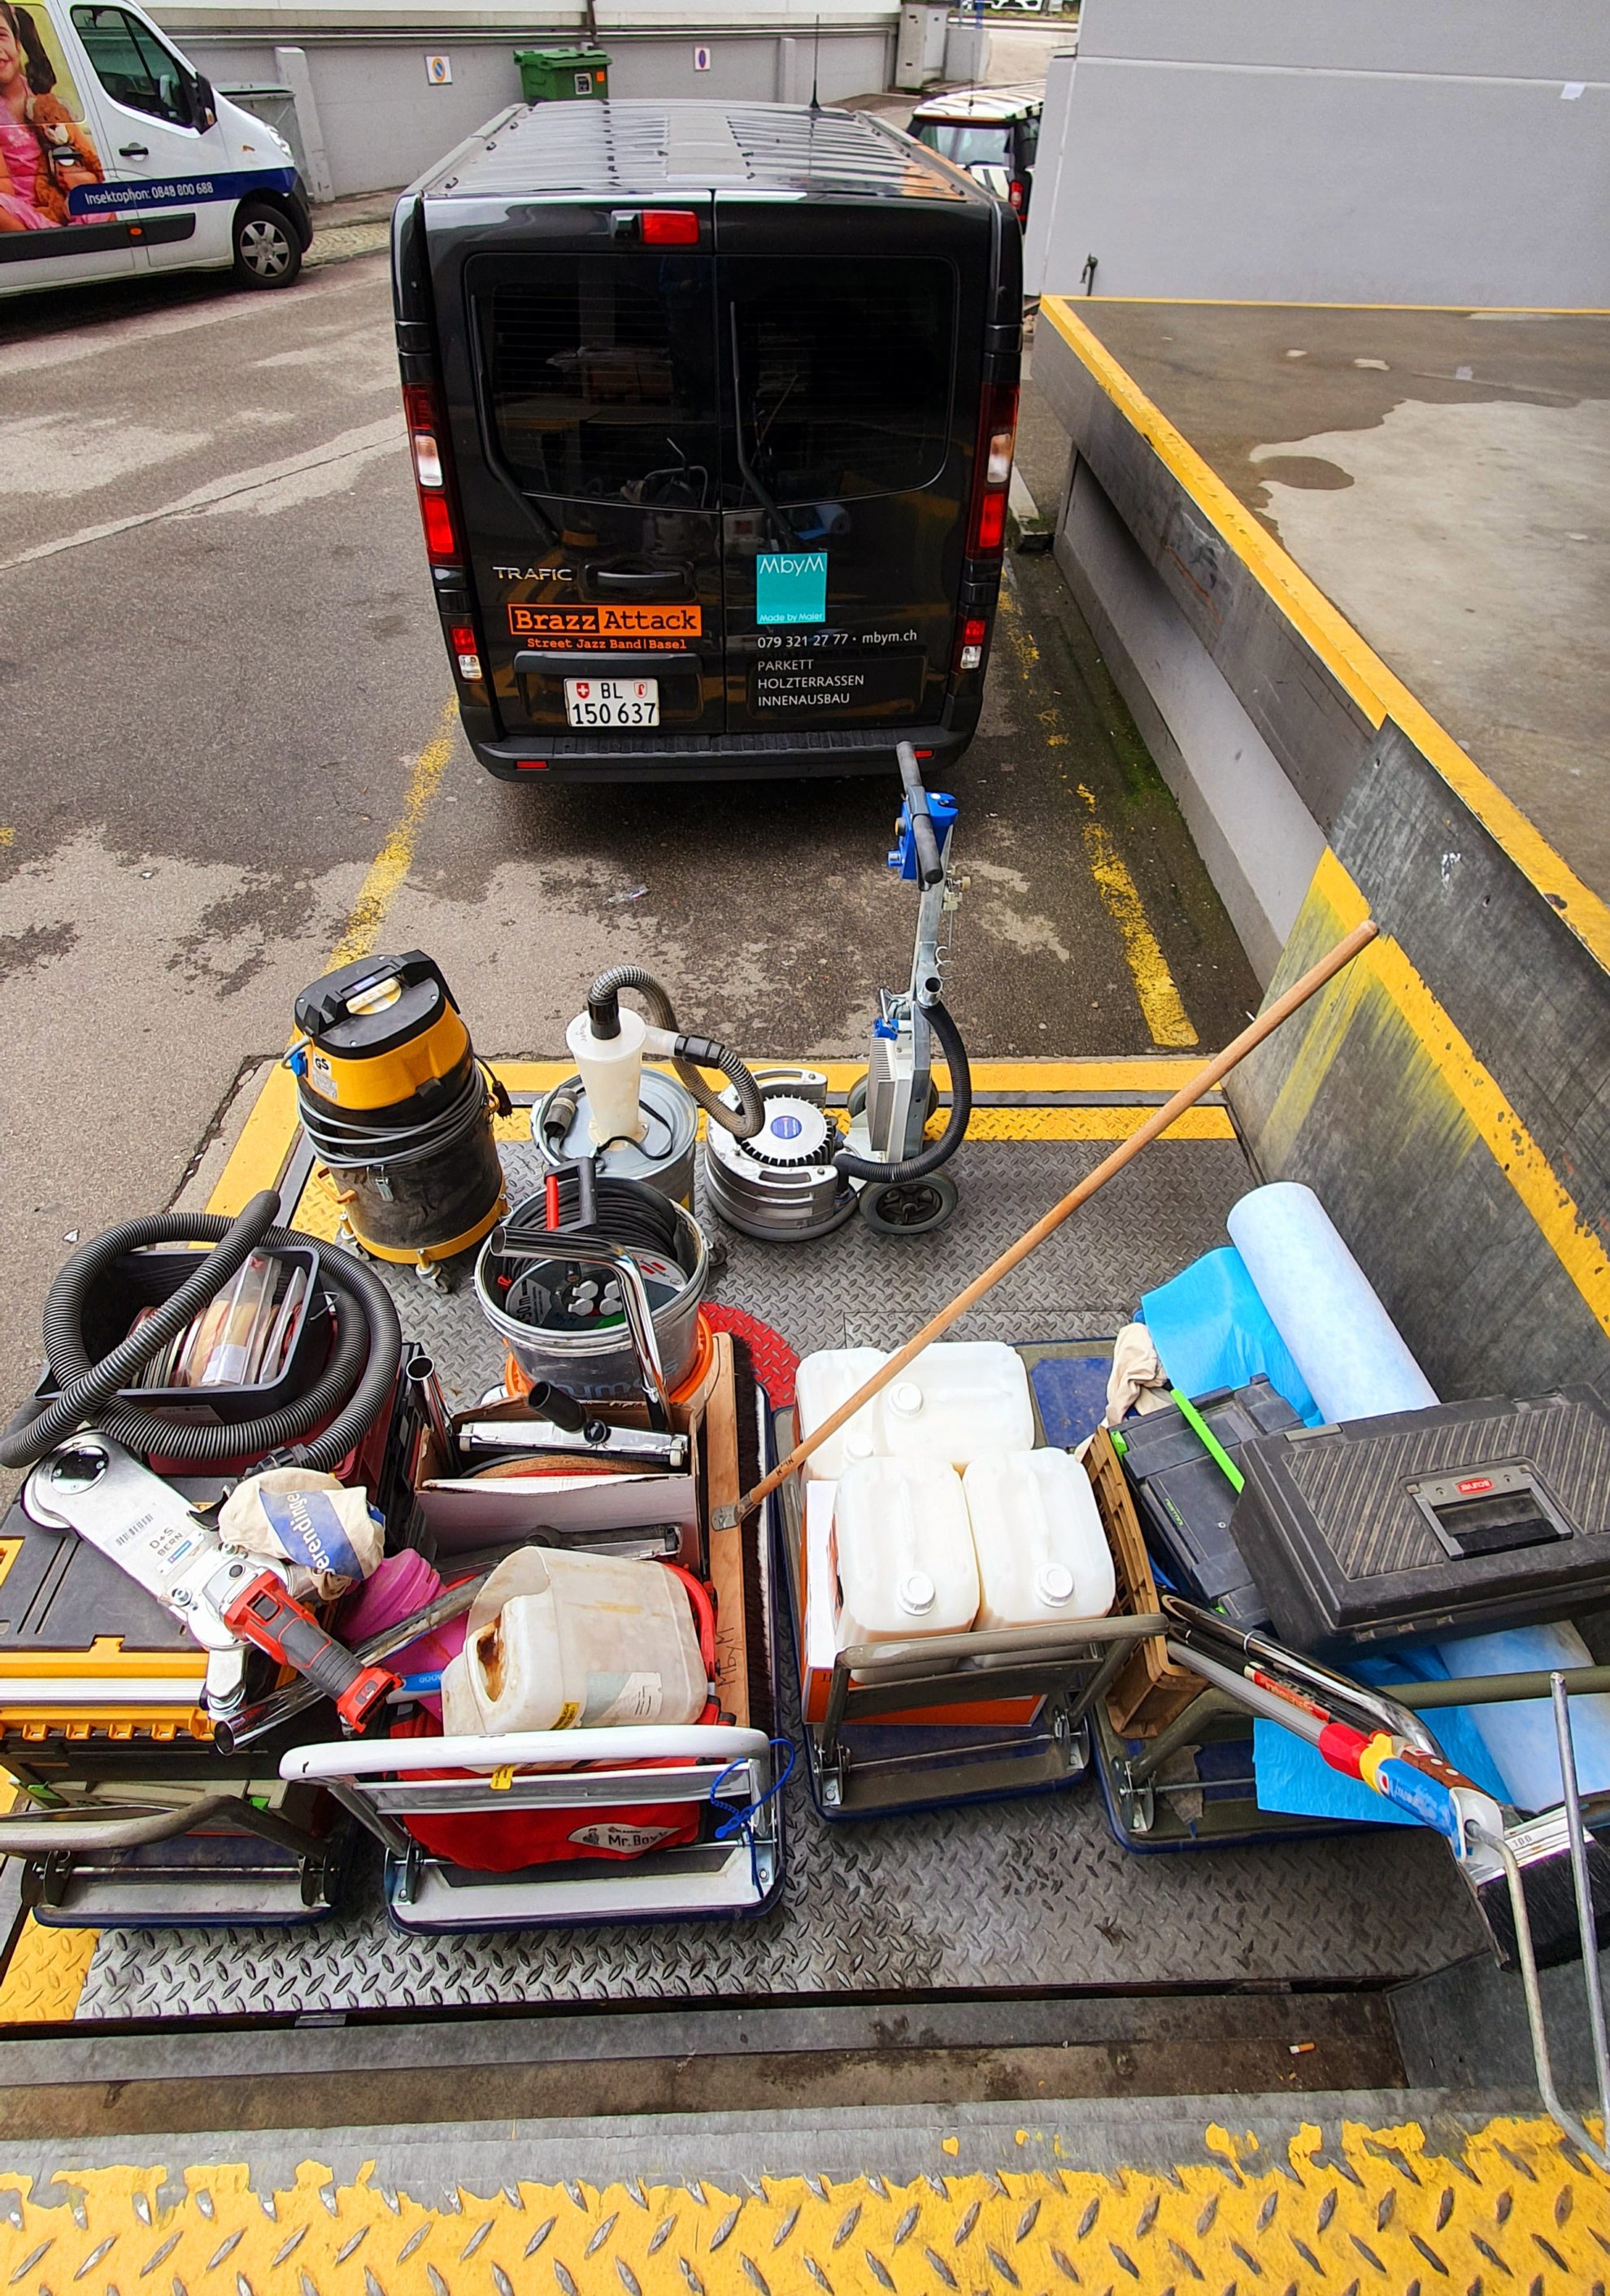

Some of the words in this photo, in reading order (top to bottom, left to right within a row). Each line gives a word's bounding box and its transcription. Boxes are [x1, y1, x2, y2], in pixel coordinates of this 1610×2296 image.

[85, 188, 151, 206] Insektophon:
[151, 185, 176, 199] 0848
[176, 184, 195, 197] 800
[195, 181, 214, 194] 688
[759, 555, 825, 576] MbyM
[493, 567, 572, 581] TRAFIC
[515, 610, 597, 630] Brazz
[603, 610, 698, 630] Attack
[759, 614, 785, 623] Made
[787, 613, 797, 622] by
[527, 638, 572, 648] Street
[576, 639, 607, 649] Jazz
[757, 637, 782, 649] 079
[785, 636, 807, 647] 321
[813, 634, 829, 646] 27
[833, 633, 848, 645] 77
[862, 629, 917, 646] mbym.ch
[757, 659, 814, 672] PARKETT
[758, 675, 864, 689] HOLZTERRASSEN
[600, 682, 624, 699] BL
[758, 693, 850, 707] INNENAUSBAU
[315, 1058, 329, 1071] GS
[158, 1532, 184, 1557] BERN
[716, 1626, 741, 1689] MbyM
